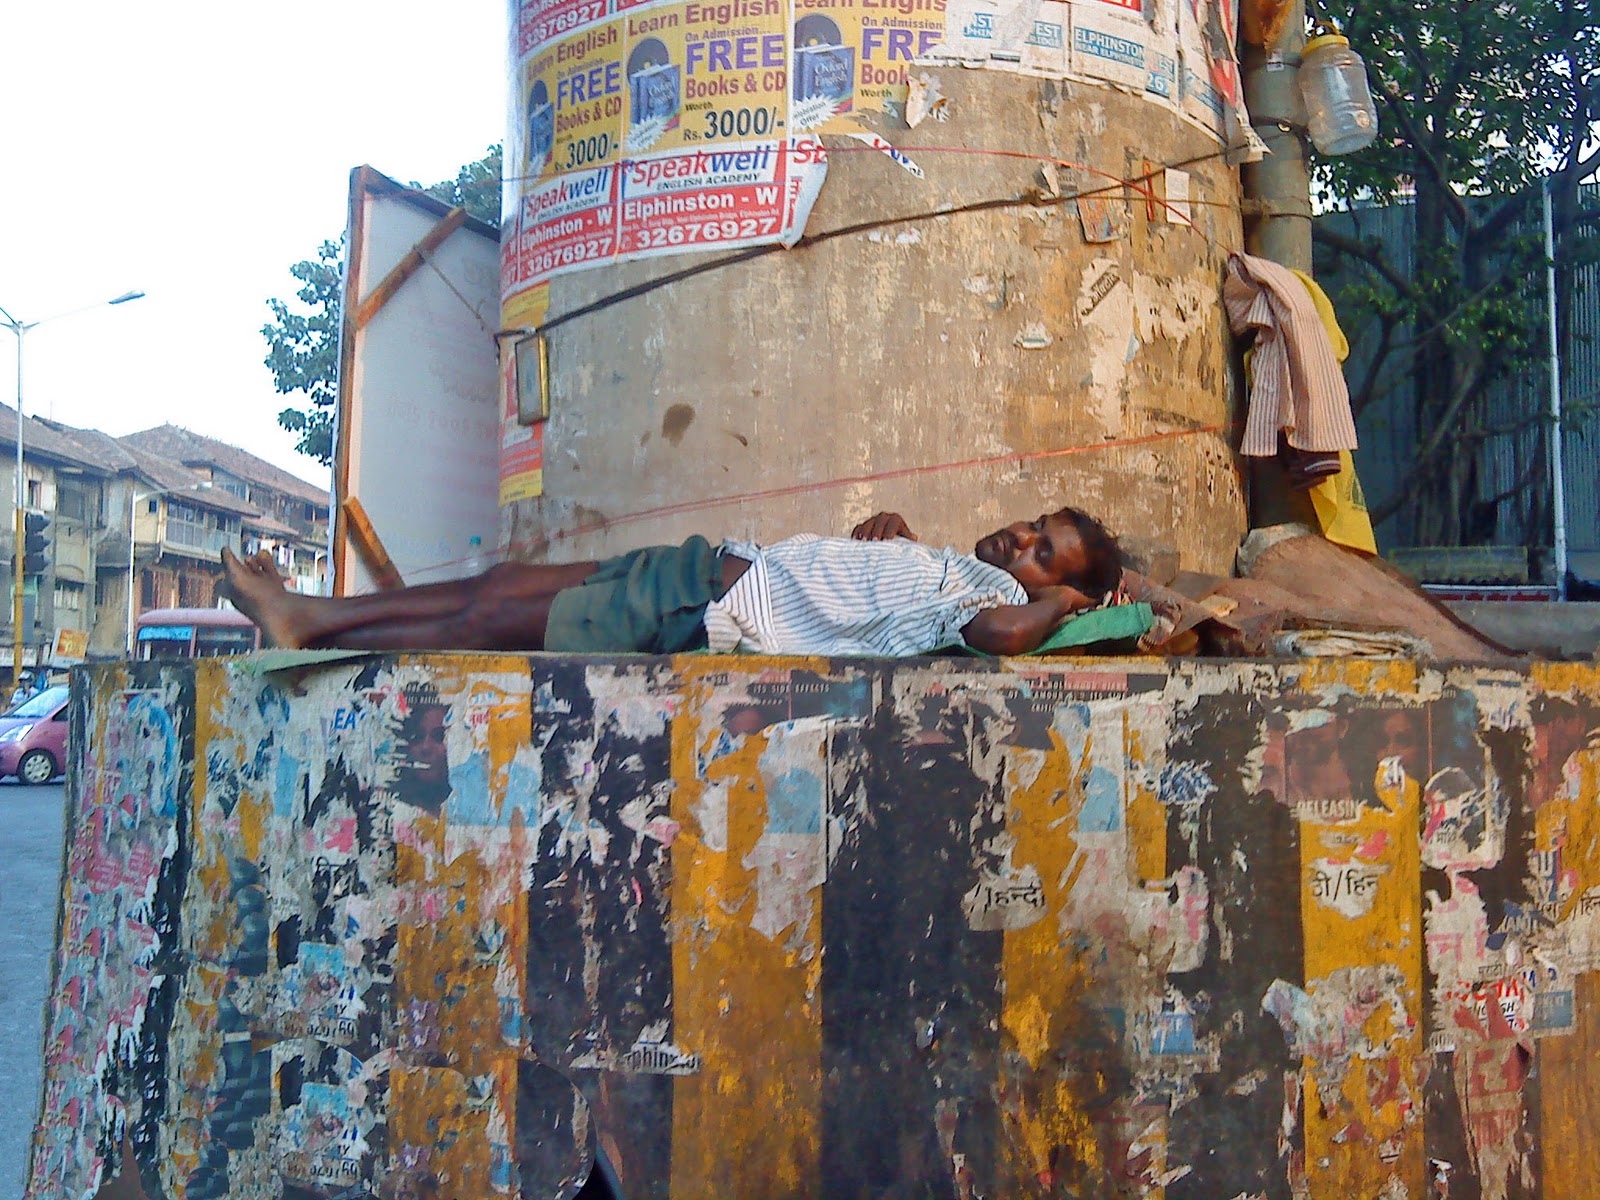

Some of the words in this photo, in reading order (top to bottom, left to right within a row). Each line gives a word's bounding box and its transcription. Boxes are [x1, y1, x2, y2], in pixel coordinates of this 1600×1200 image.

[629, 12, 679, 37] Learn
[685, 0, 779, 25] English
[685, 32, 699, 42] On
[862, 16, 877, 27] On
[557, 25, 618, 63] English
[685, 34, 785, 75] FREE
[557, 61, 620, 110] FREE
[685, 74, 739, 99] Books
[744, 72, 758, 93] &
[763, 70, 787, 91] CD
[860, 88, 893, 98] Worth
[556, 109, 590, 133] Books
[593, 102, 604, 122] &
[605, 95, 622, 118] CD
[704, 106, 785, 140] 3000/-
[565, 131, 619, 170] 3000/-
[632, 145, 771, 187] Speakwell
[525, 165, 608, 218] Speakwell
[657, 178, 703, 192] ENGLISH
[706, 173, 760, 186] ACADEMY
[625, 191, 735, 222] Elphinston
[755, 186, 779, 206] W
[522, 217, 584, 251] Elphinston
[597, 206, 613, 227] W
[637, 216, 777, 249] 32676927
[526, 237, 613, 277] 32676927
